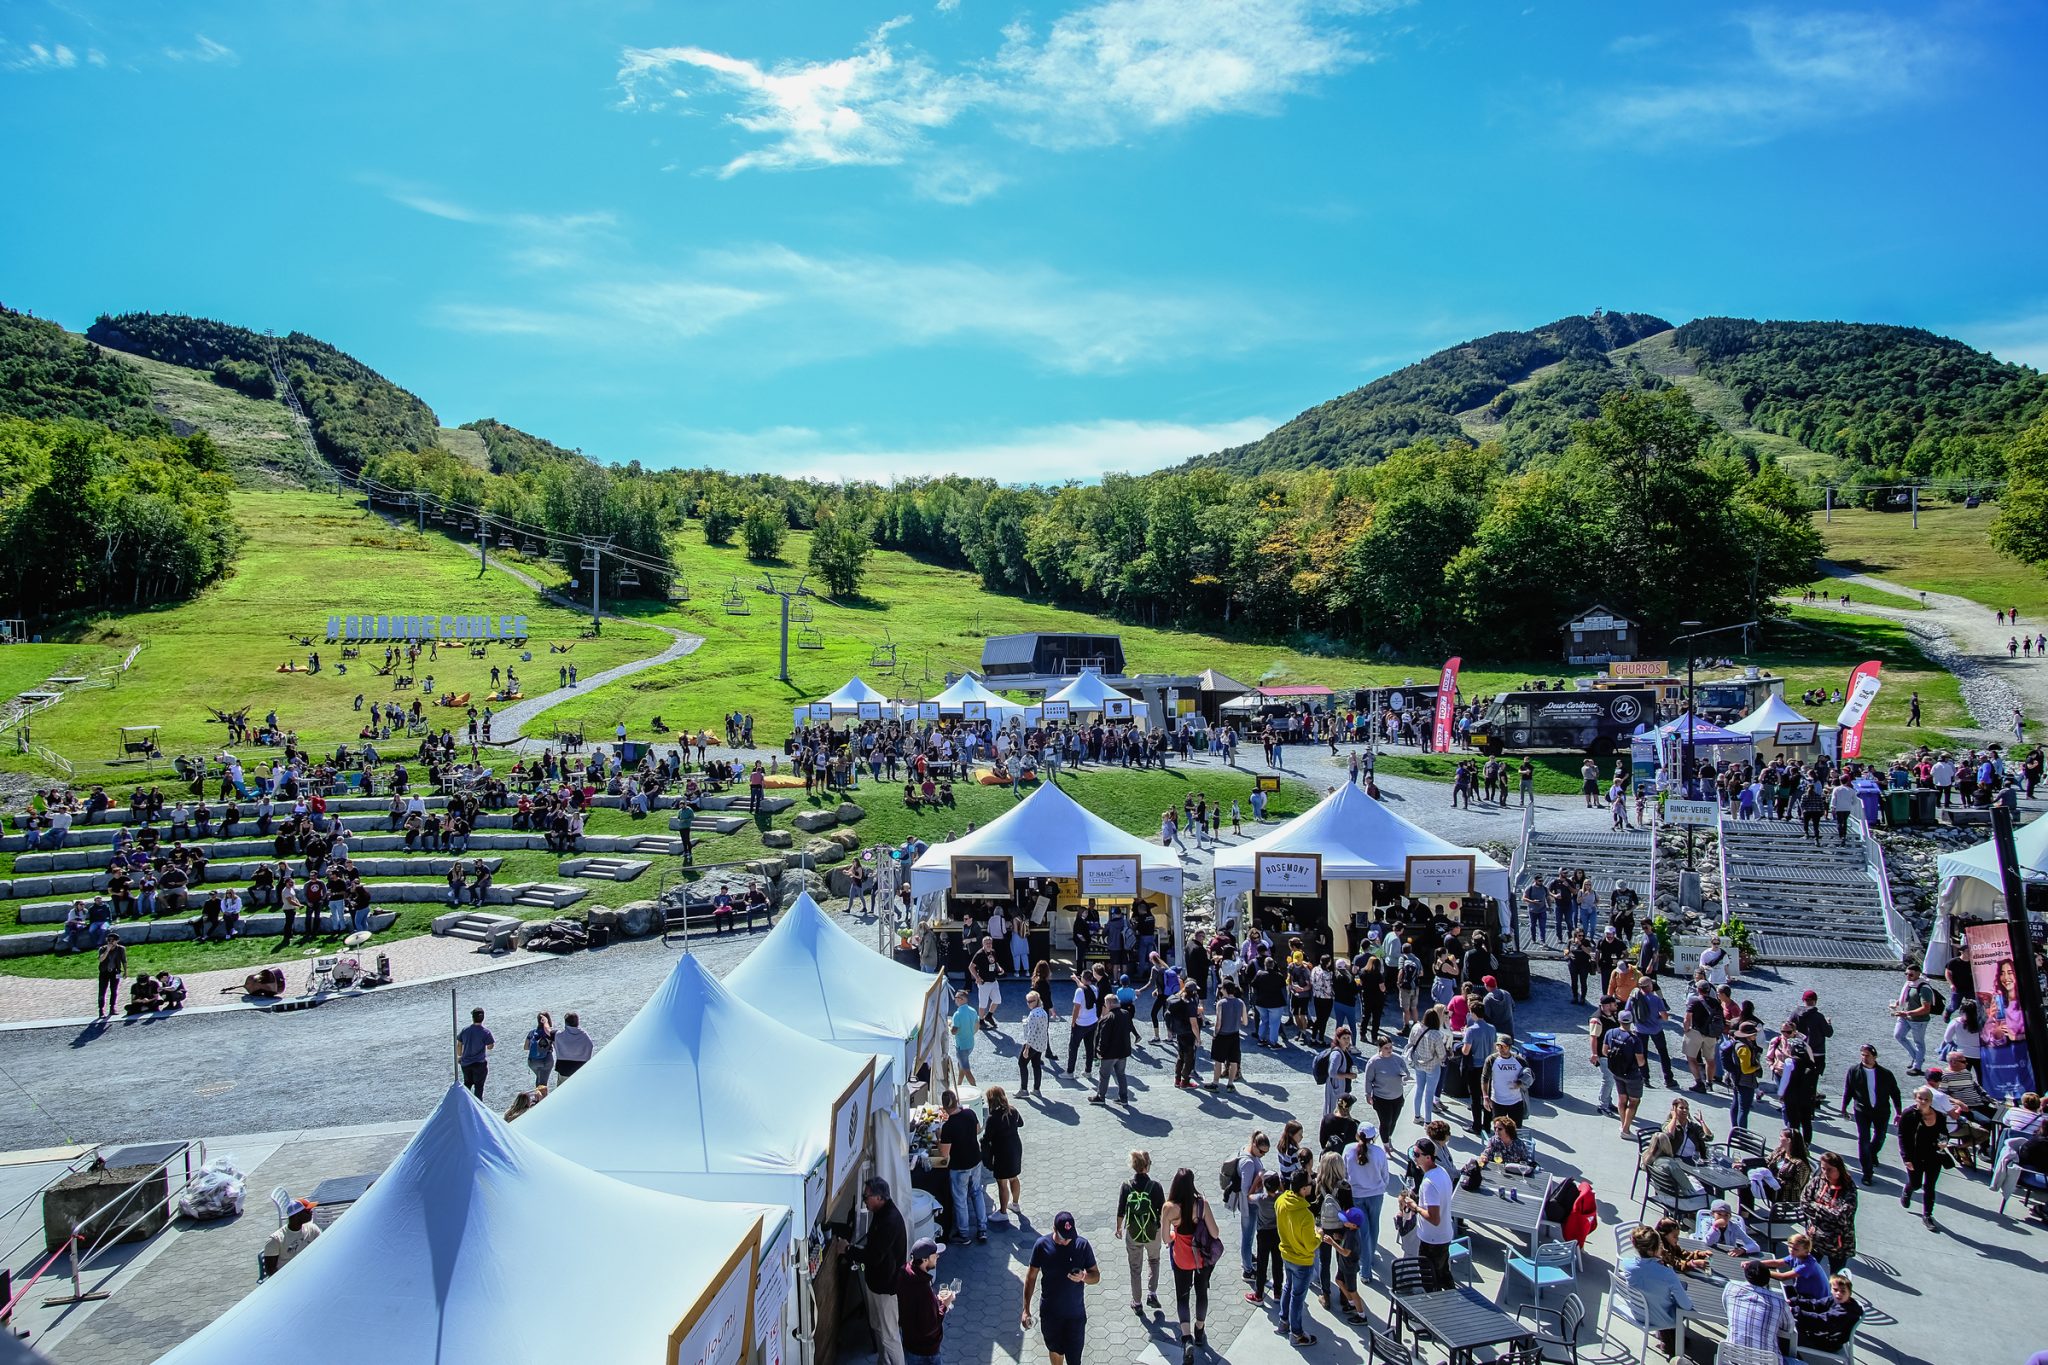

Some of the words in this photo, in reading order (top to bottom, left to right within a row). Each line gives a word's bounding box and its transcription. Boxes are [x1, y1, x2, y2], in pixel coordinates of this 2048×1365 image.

[1615, 663, 1661, 675] CHURROS
[1443, 669, 1451, 690] 102.7
[1566, 701, 1598, 709] Caribous
[1670, 805, 1712, 814] RINCE-VERRE
[1265, 863, 1309, 875] ROSEMONT
[1497, 1063, 1517, 1071] VANS
